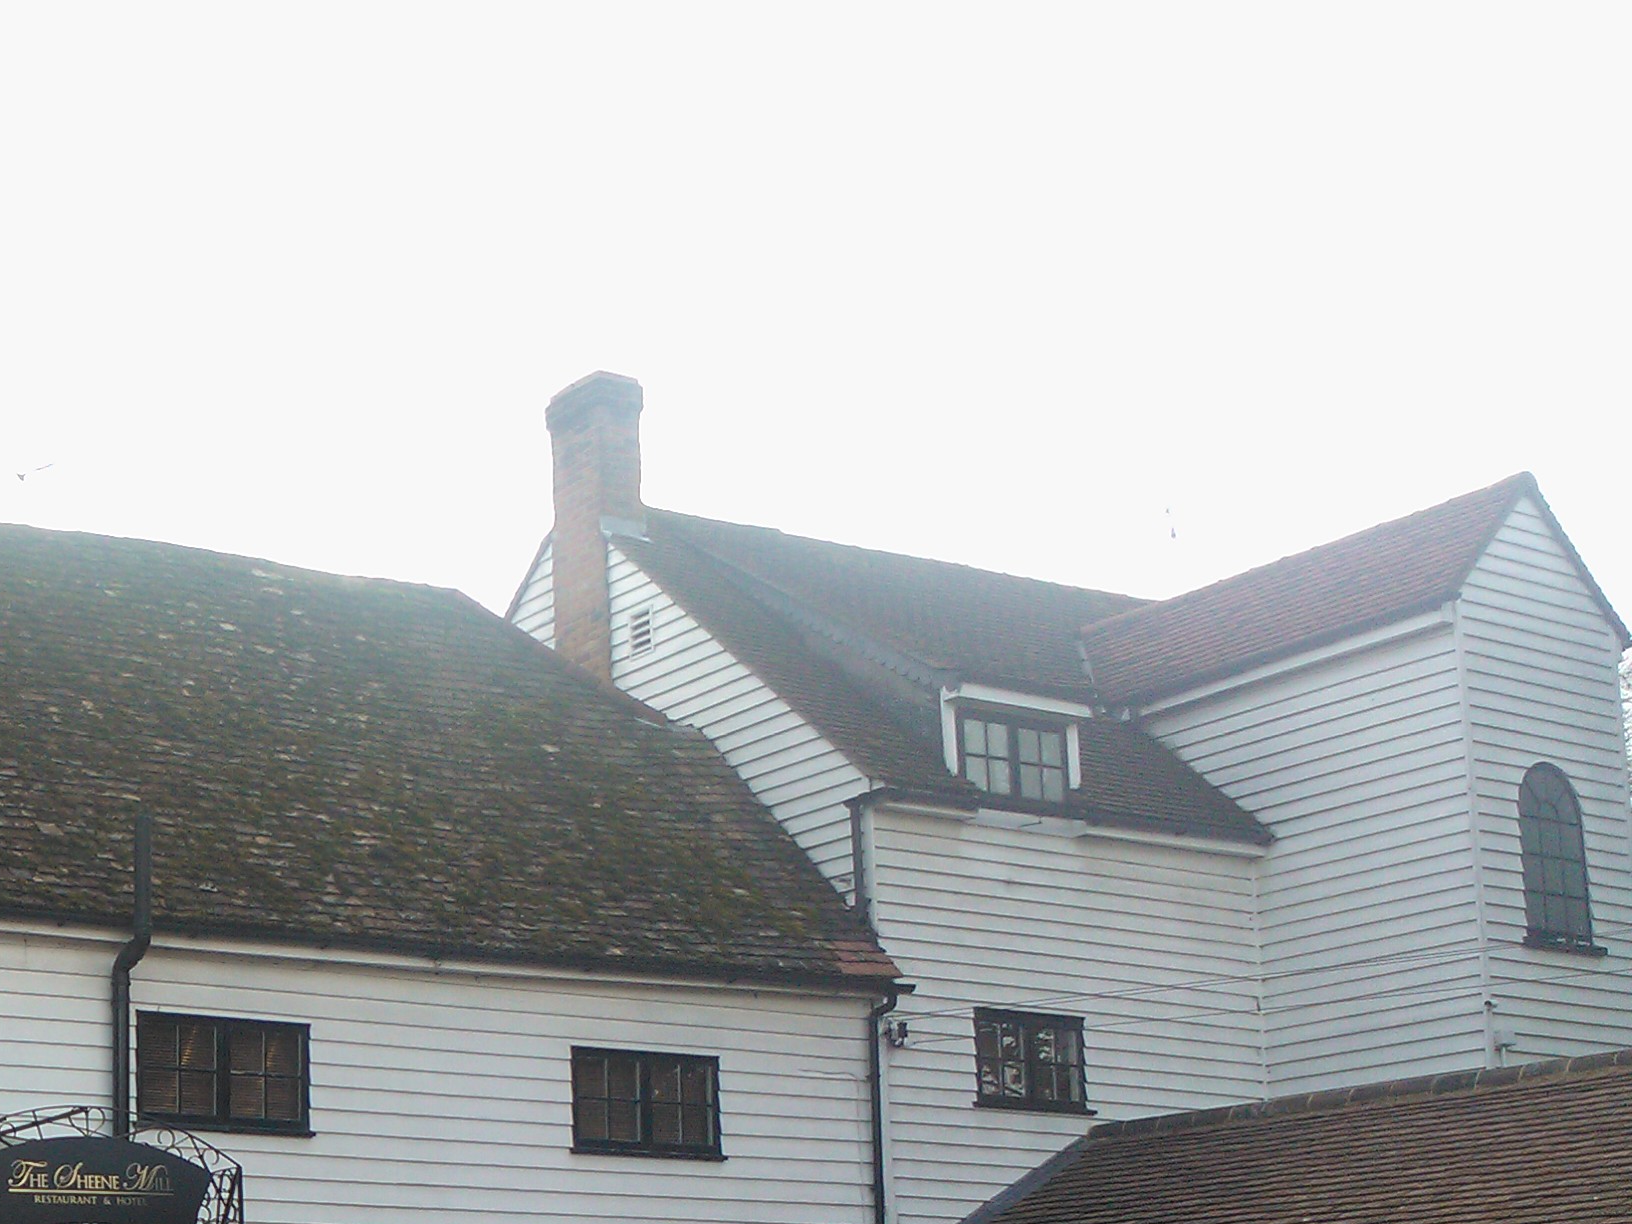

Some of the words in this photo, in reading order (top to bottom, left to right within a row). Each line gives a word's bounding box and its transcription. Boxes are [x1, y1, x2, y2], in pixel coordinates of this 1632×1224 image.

[53, 1162, 120, 1190] SHEENE
[123, 1162, 174, 1191] MILL
[34, 1194, 97, 1205] RESTAURANT
[103, 1196, 112, 1206] &
[117, 1197, 148, 1207] HOTEL
